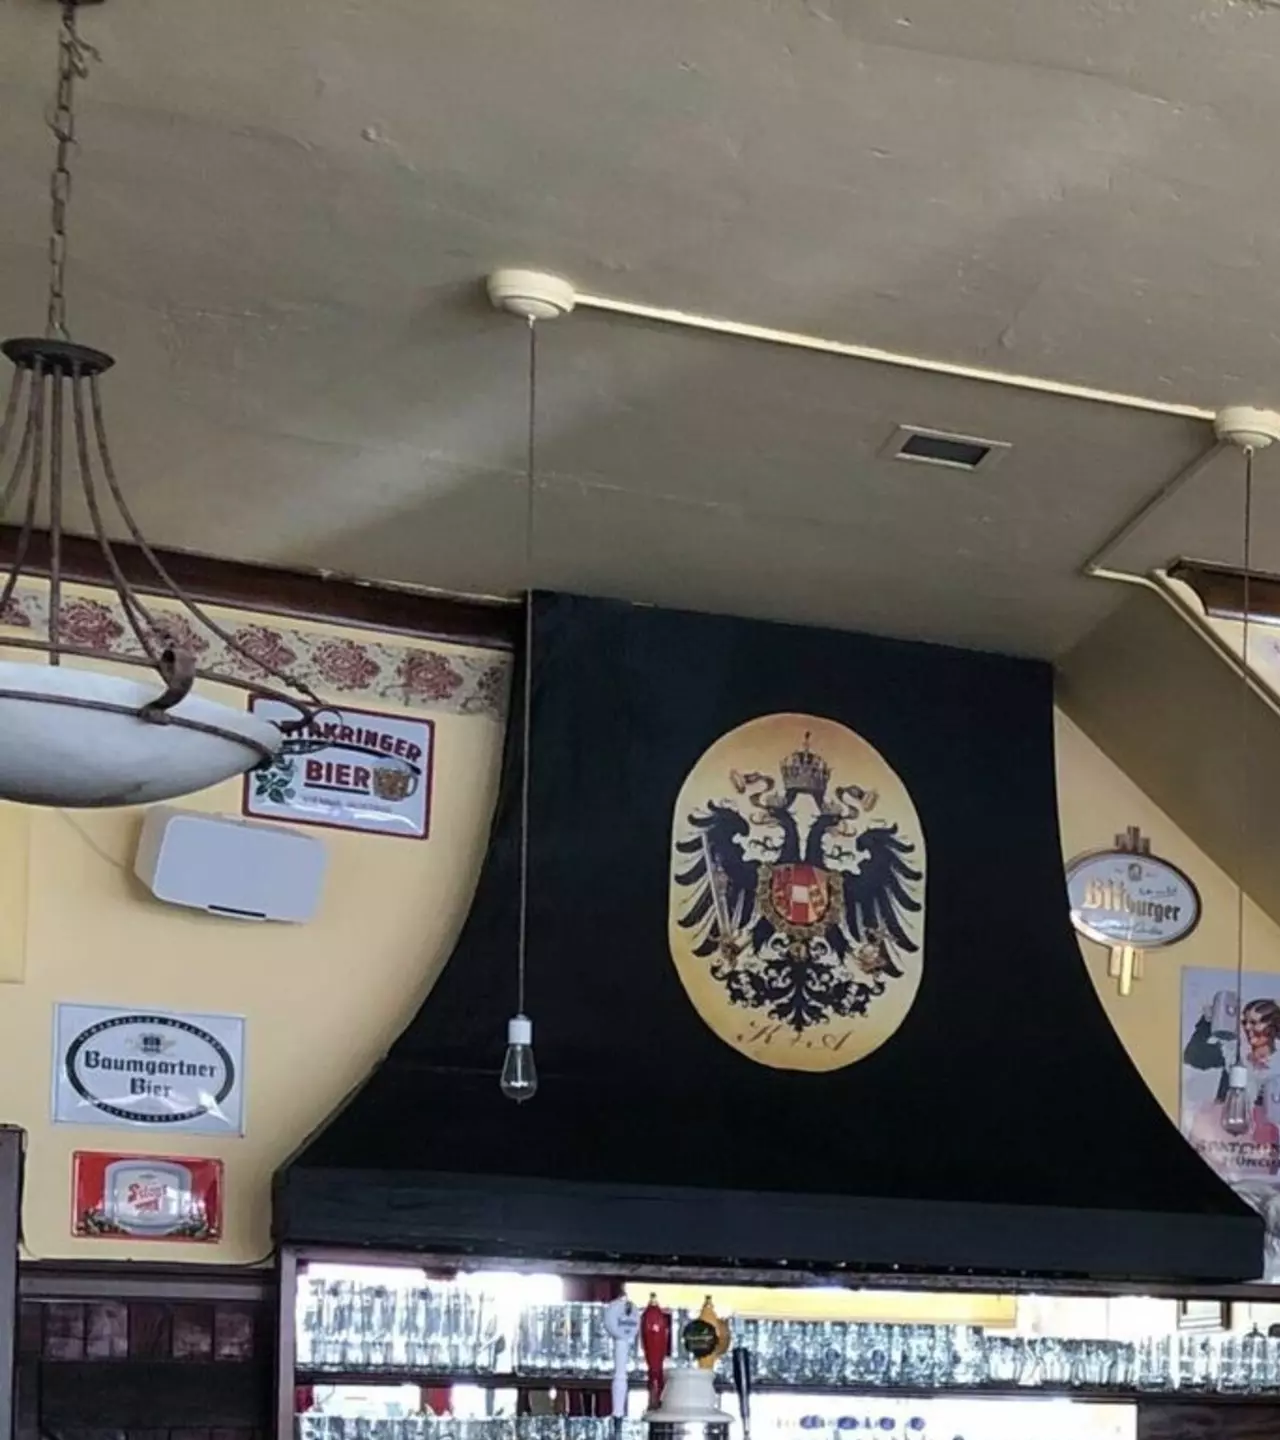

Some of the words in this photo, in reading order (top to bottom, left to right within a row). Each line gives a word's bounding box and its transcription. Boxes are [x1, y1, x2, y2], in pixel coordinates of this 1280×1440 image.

[305, 759, 371, 788] BIER
[1081, 877, 1181, 923] Bitburger
[84, 1051, 217, 1078] Baumgartner
[130, 1077, 173, 1098] Bier
